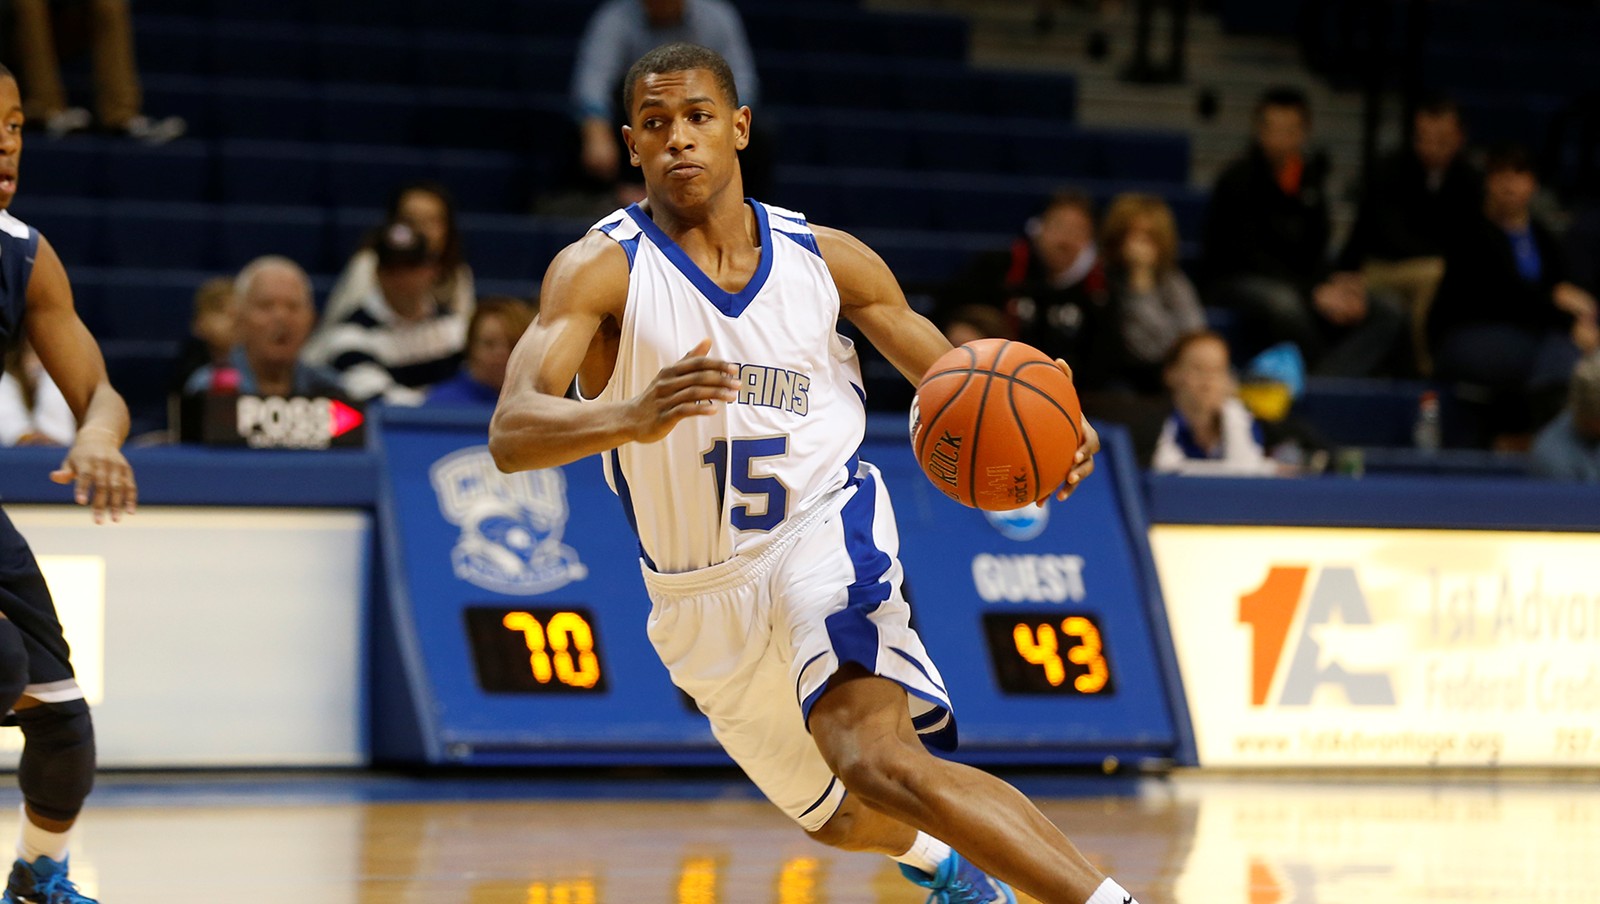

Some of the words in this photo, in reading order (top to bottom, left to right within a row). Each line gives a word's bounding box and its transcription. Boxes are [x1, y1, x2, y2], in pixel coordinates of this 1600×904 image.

[237, 395, 332, 438] POSS
[699, 433, 791, 535] 15
[928, 430, 962, 487] ROCK
[1014, 472, 1028, 504] ROCK
[971, 552, 1086, 603] GUEST
[502, 611, 600, 689] 70
[1013, 616, 1110, 694] 43
